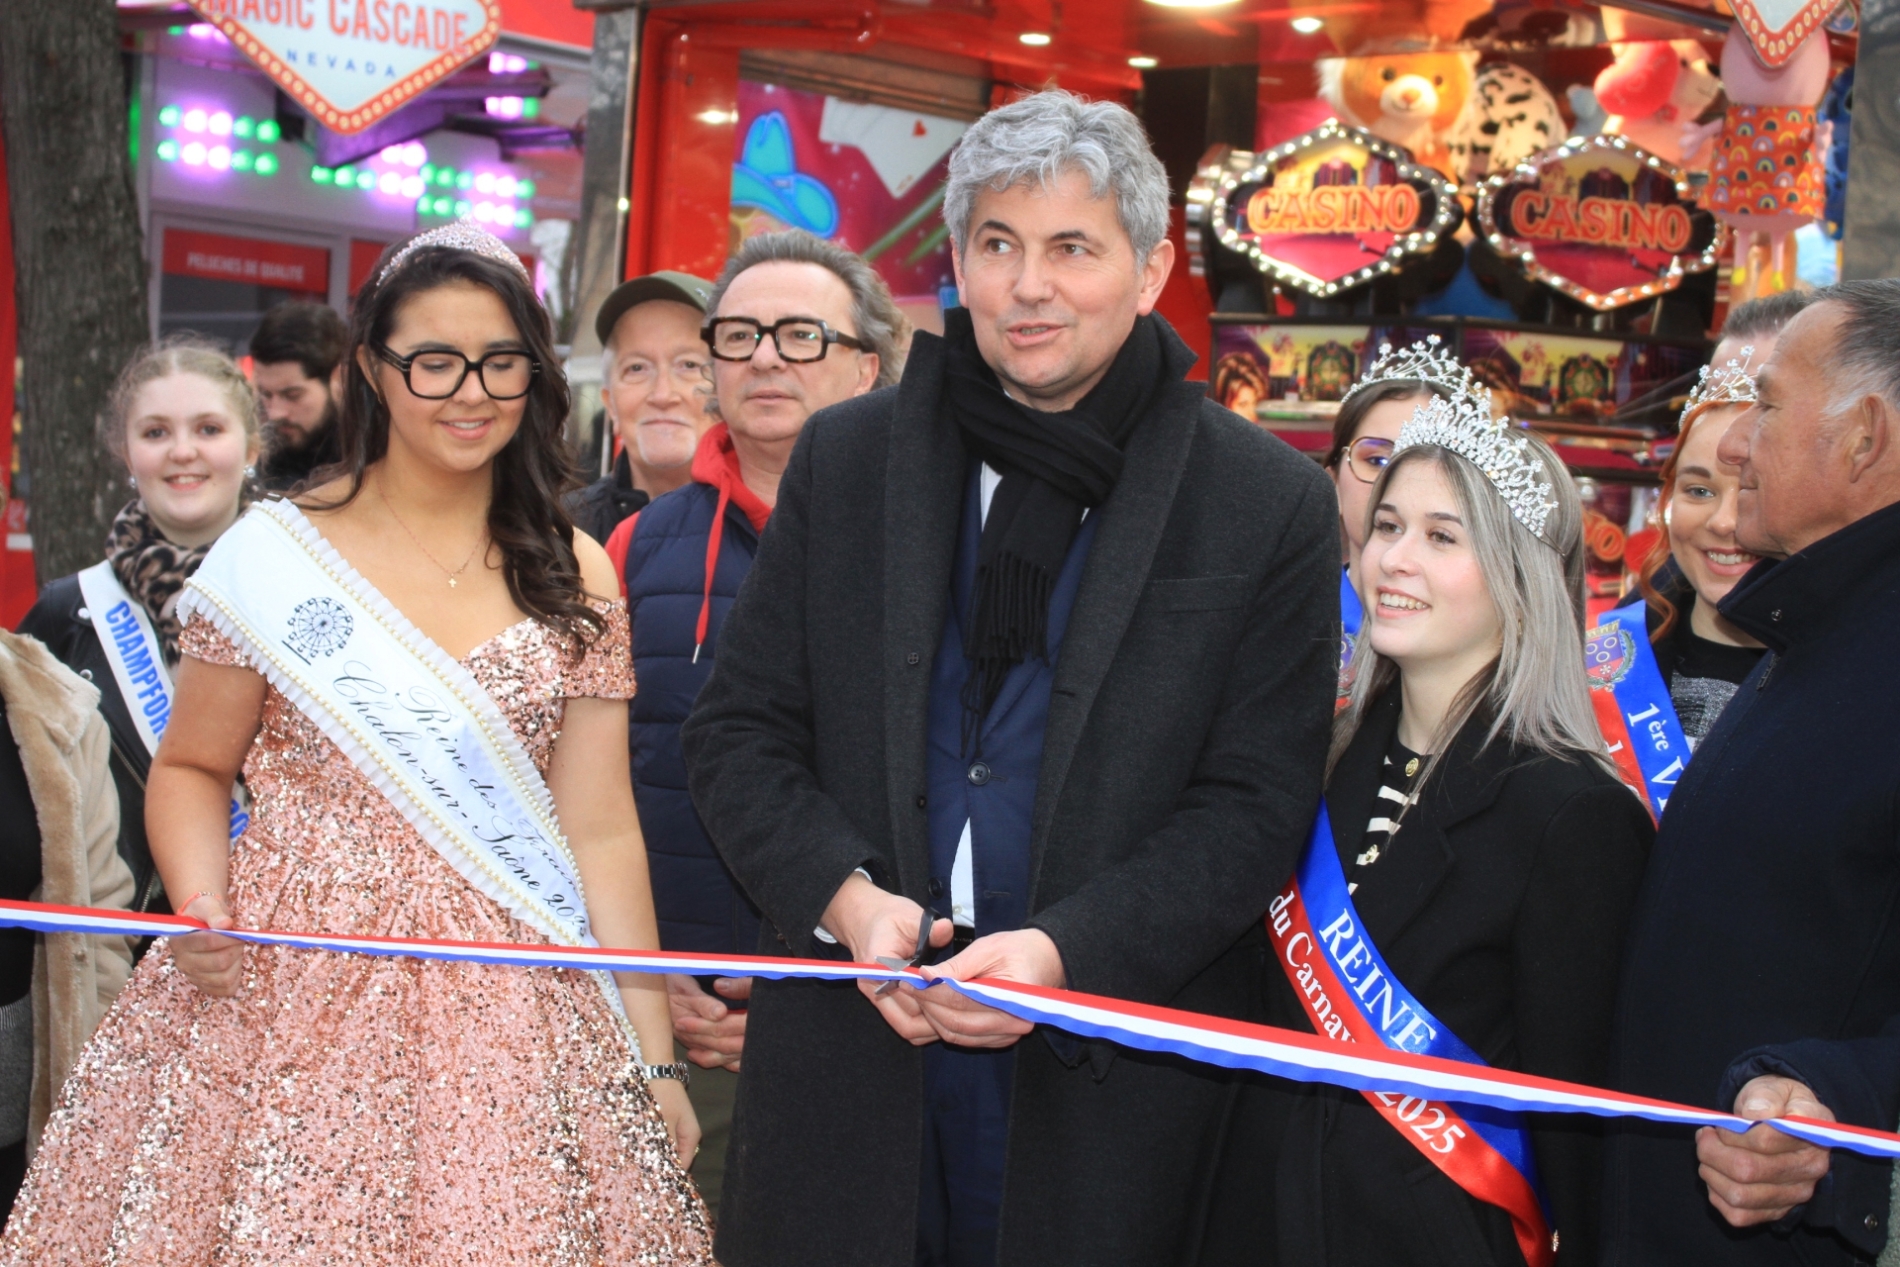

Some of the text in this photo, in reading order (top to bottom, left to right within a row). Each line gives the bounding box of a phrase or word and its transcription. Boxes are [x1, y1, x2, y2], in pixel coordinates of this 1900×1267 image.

[329, 0, 468, 54] CASCADE
[286, 48, 397, 78] NEVADA
[1248, 183, 1420, 234] CASINO
[1511, 191, 1692, 252] CASINO
[104, 600, 172, 743] CHAMPFOR
[395, 684, 468, 774] Reine
[468, 777, 498, 811] des
[1627, 702, 1670, 752] 1ère
[1269, 890, 1296, 938] du
[1319, 907, 1438, 1055] REINE
